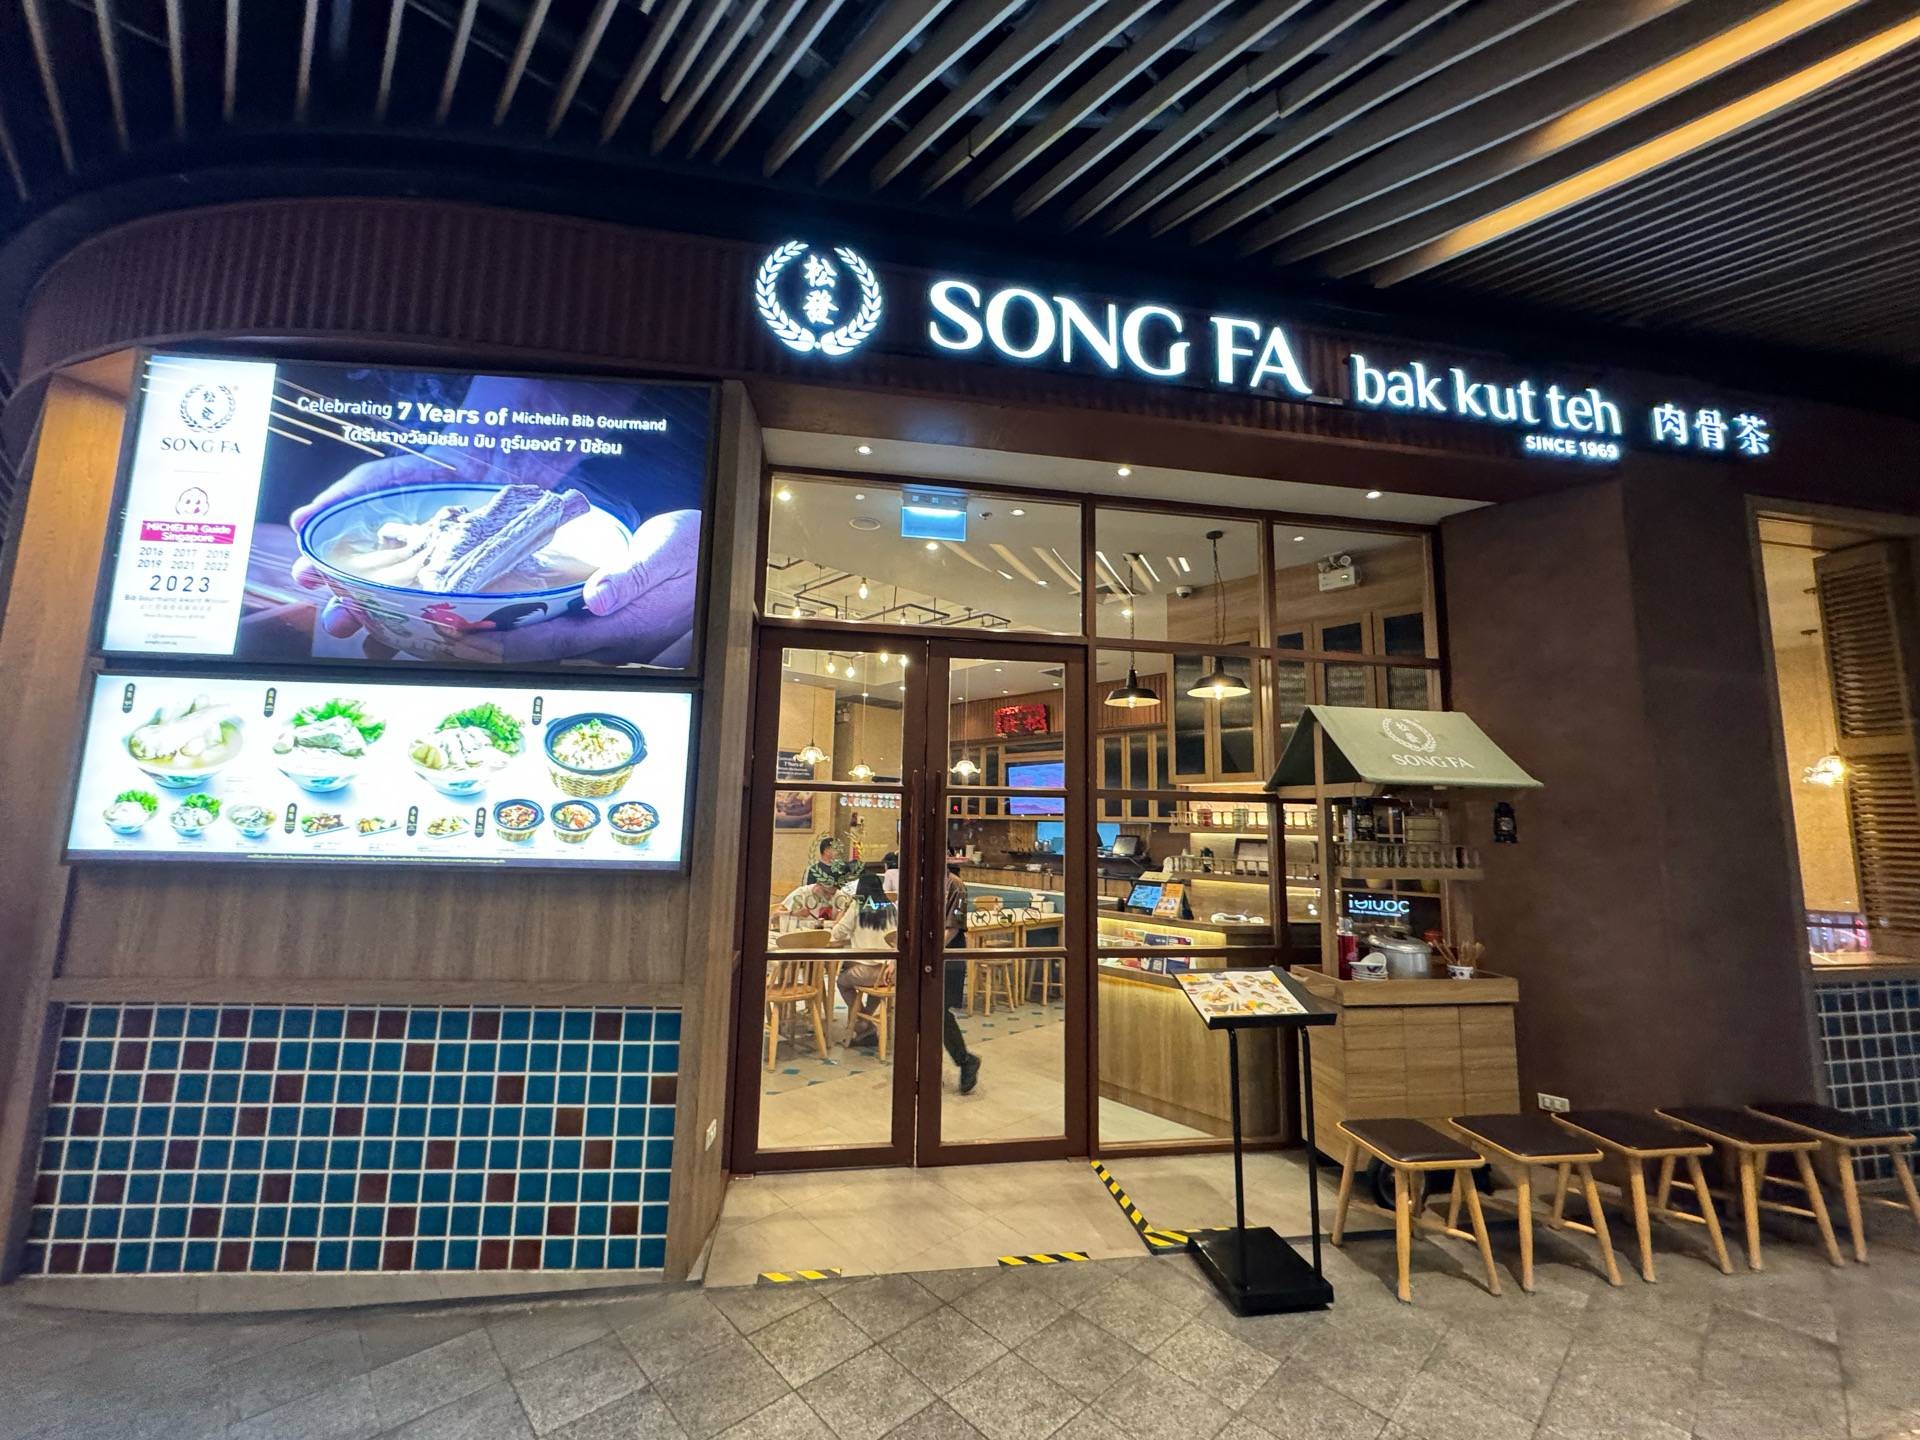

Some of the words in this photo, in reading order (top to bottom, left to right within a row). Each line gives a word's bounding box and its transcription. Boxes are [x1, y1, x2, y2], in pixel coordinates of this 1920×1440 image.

[803, 254, 839, 325] 松發
[929, 280, 1191, 377] SONG
[1209, 316, 1313, 395] FA
[1350, 353, 1448, 412] bak
[1449, 367, 1541, 424] kut
[1545, 384, 1623, 435] teh
[297, 397, 393, 419] Celebrating
[397, 401, 412, 421] 7
[417, 402, 480, 425] Years
[485, 407, 508, 426] of
[512, 411, 569, 427] Michelin
[572, 414, 595, 428] Bib
[597, 416, 667, 431] Gourmand
[1652, 402, 1772, 455] 肉骨茶
[160, 437, 215, 453] SONG
[220, 440, 241, 454] FA
[565, 440, 577, 452] 7
[1525, 435, 1577, 456] SINCE
[1579, 441, 1620, 460] 1969
[139, 546, 163, 557] 2016
[172, 547, 198, 558] 2017
[149, 574, 210, 593] 2023
[1391, 753, 1448, 768] SONG
[1444, 756, 1475, 769] FA
